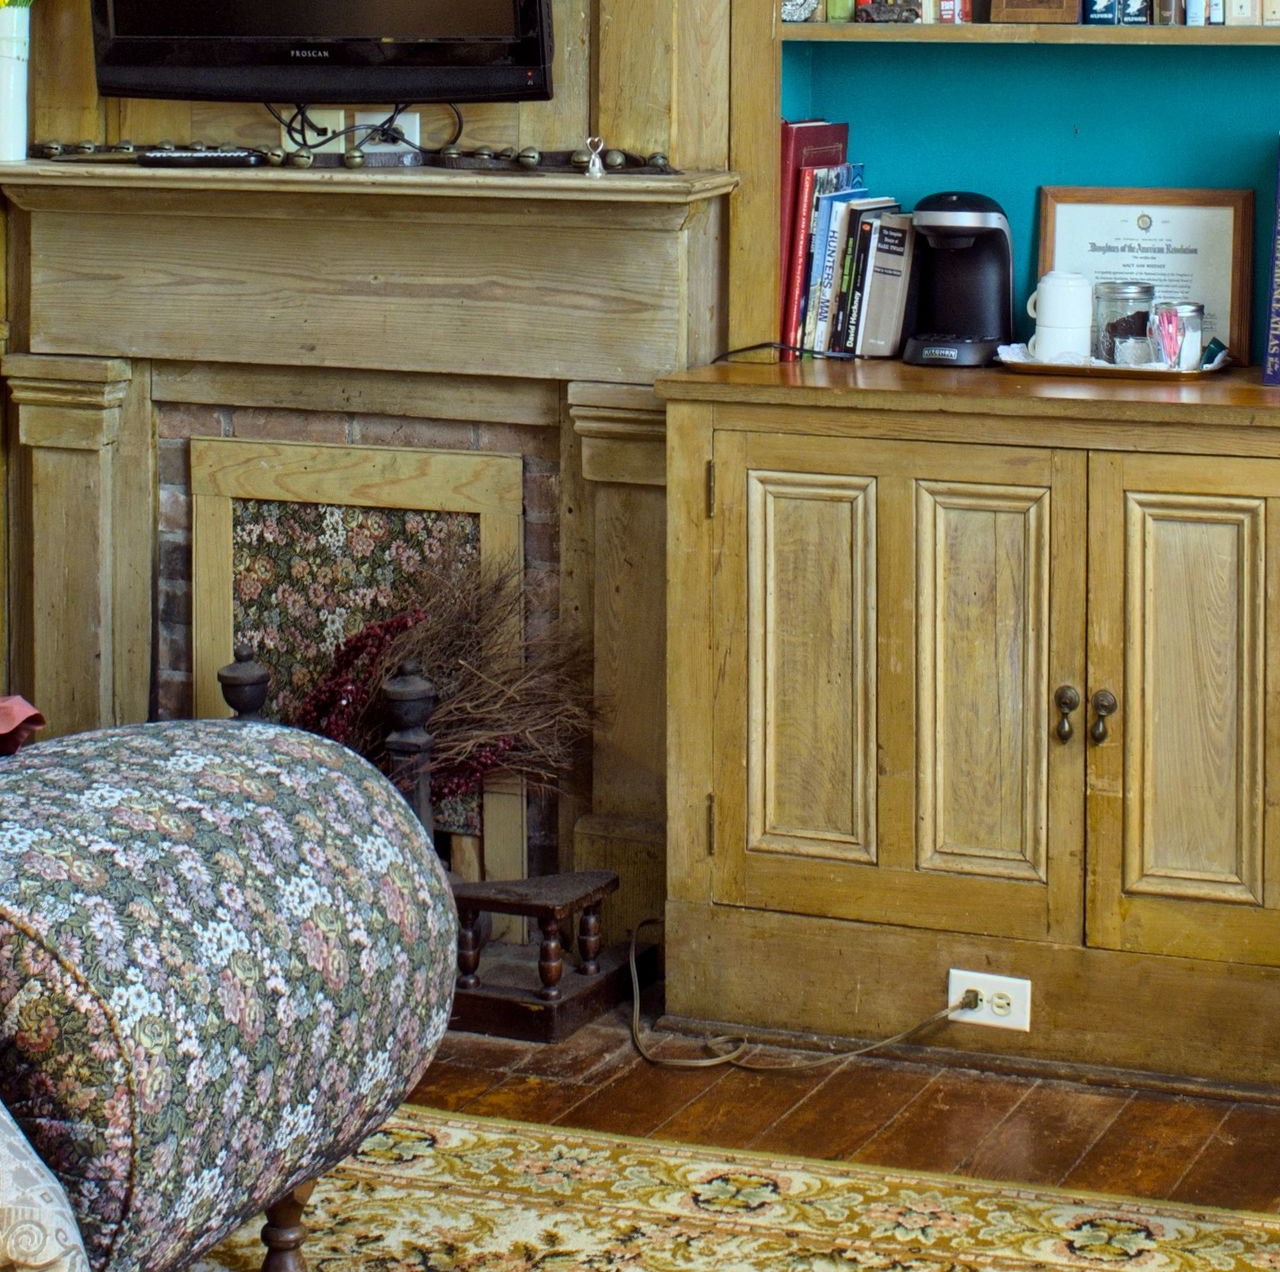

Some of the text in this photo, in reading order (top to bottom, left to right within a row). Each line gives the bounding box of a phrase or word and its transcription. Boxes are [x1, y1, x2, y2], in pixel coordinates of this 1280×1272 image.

[818, 229, 839, 323] HUNTERS MAN
[846, 290, 862, 347] David Hockney
